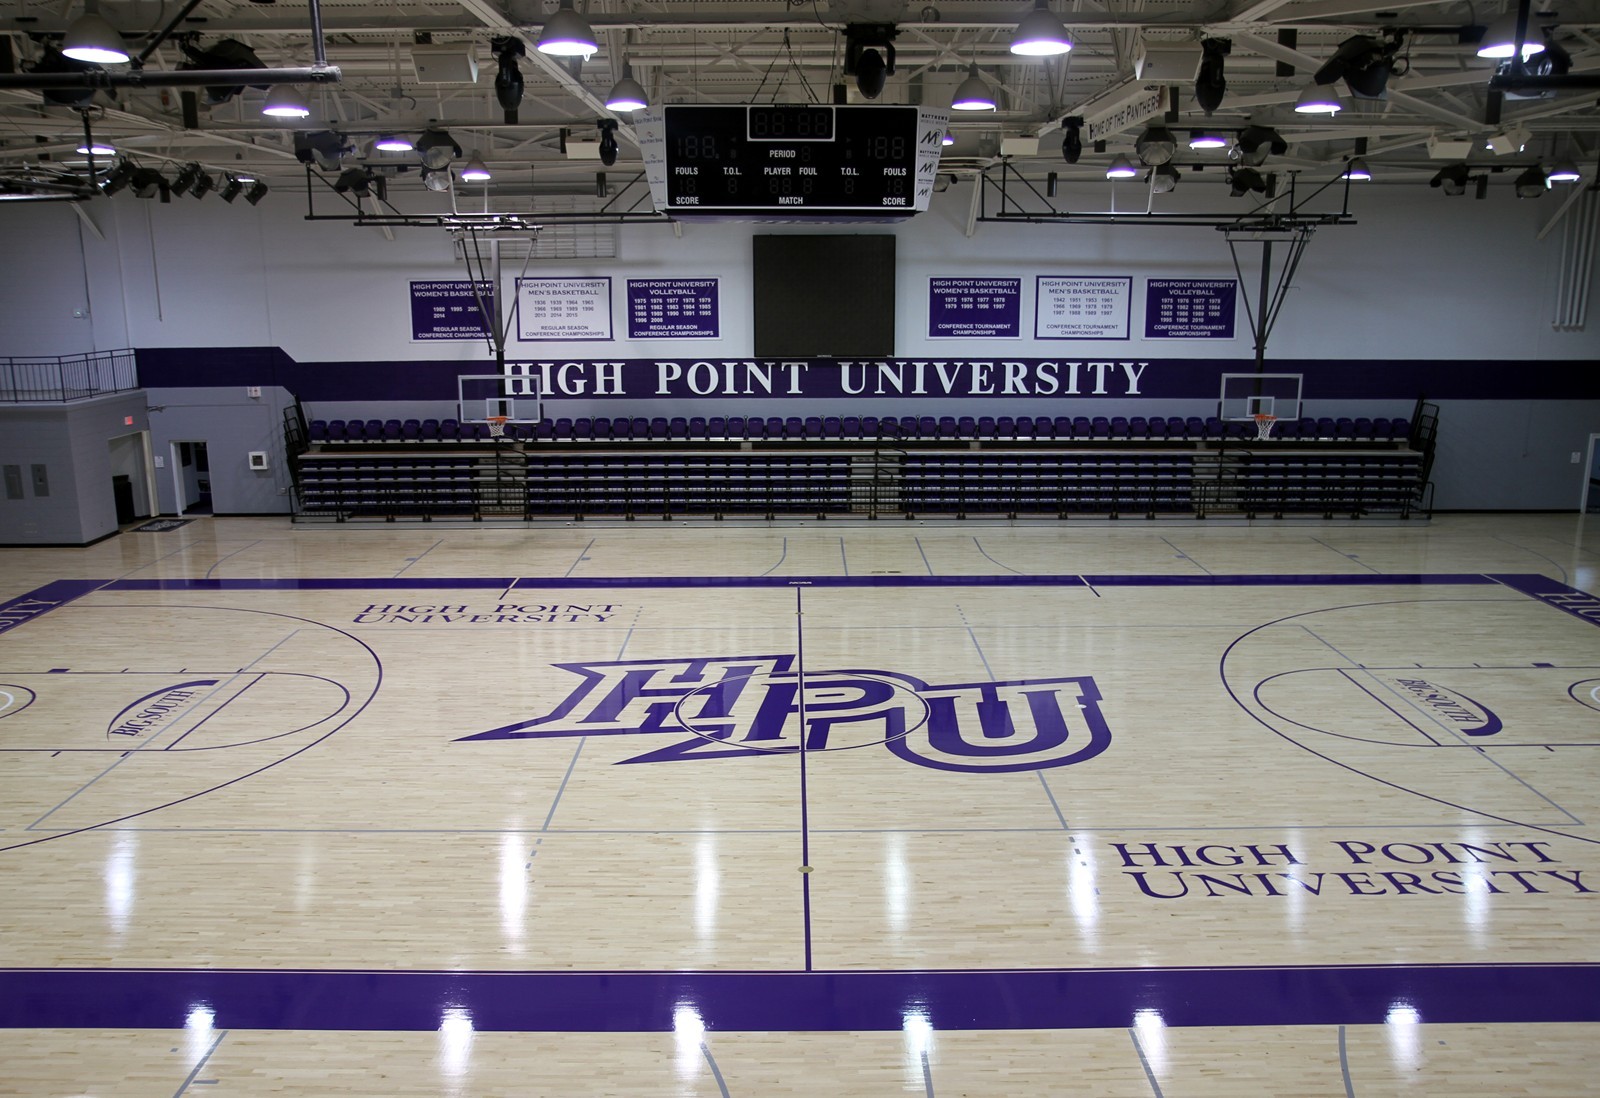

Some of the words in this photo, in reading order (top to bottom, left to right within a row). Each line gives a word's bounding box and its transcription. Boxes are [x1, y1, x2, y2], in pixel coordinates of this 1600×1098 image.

[1114, 110, 1124, 130] THE
[1126, 94, 1160, 122] PANTHERS
[723, 167, 742, 175] T.O.L.
[504, 362, 626, 395] HIGH
[654, 362, 808, 394] POINT
[838, 362, 1148, 394] UNIVERSITY
[352, 614, 616, 624] UNIVERSITY
[362, 604, 470, 614] HIGH
[493, 604, 622, 613] POINT
[111, 720, 152, 736] BIG
[136, 691, 194, 720] SOUTH
[451, 654, 1112, 773] HPU
[1108, 843, 1307, 867] HIGH
[1331, 841, 1562, 864] POINT
